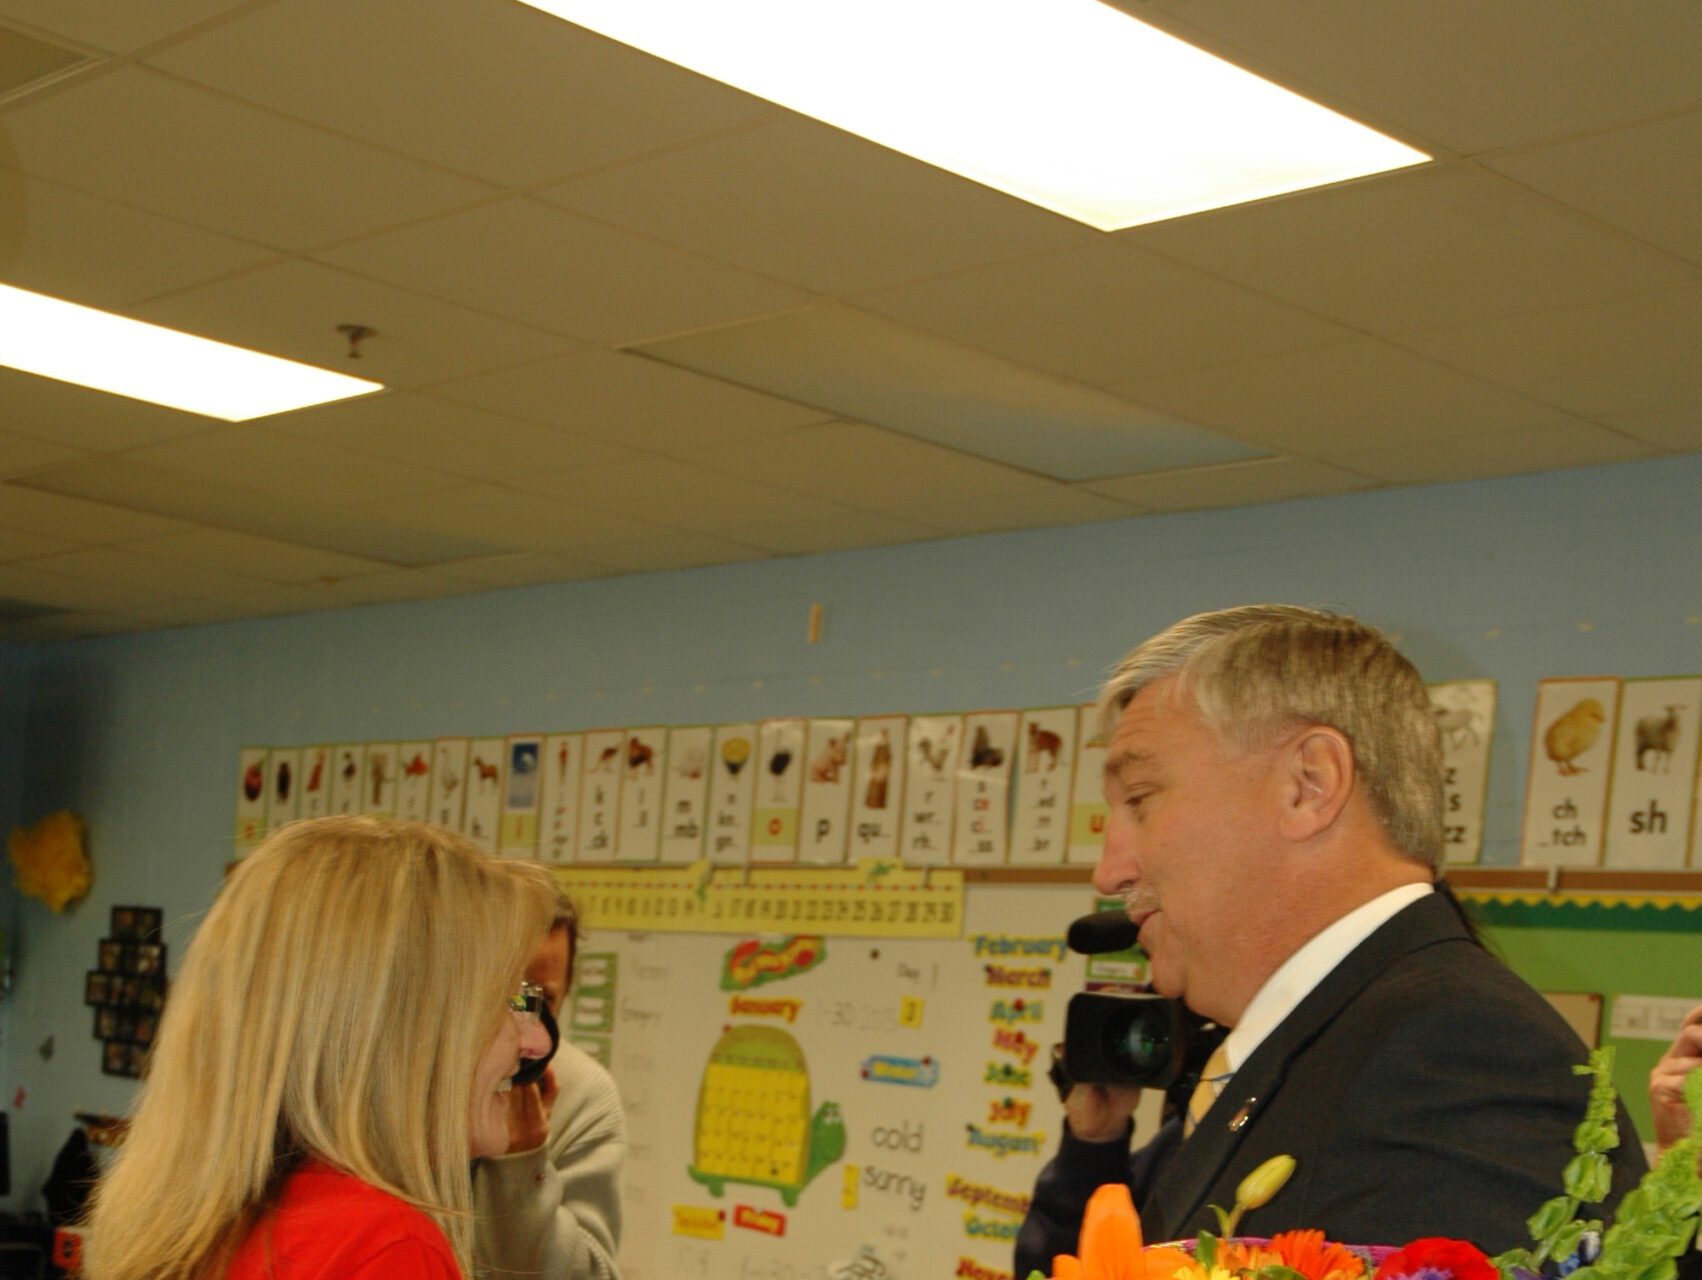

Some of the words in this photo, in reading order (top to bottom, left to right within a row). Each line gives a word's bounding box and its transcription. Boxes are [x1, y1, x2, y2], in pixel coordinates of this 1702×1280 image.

[1552, 797, 1578, 819] ch
[1629, 798, 1667, 834] sh
[816, 819, 831, 844] p
[975, 935, 1067, 963] February
[870, 1119, 924, 1153] cold
